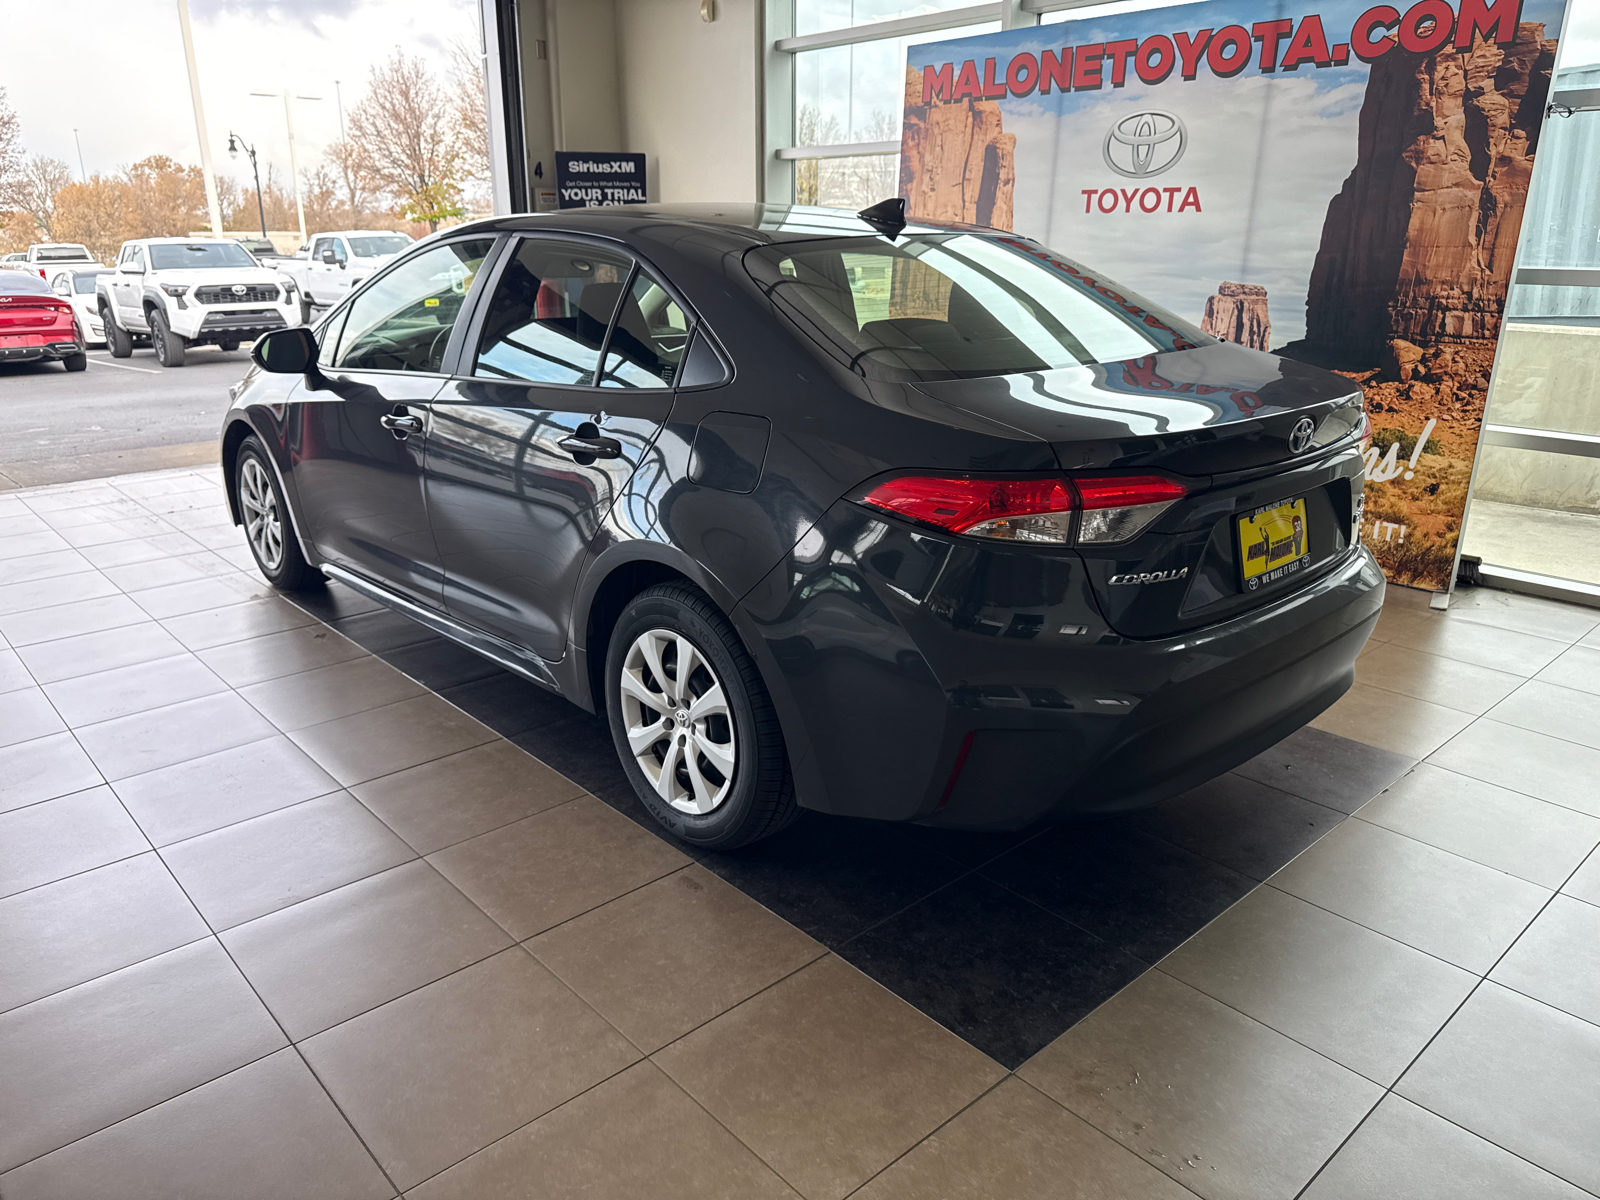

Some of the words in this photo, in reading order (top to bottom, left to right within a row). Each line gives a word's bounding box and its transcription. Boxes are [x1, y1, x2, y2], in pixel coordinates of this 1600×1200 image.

[922, 0, 1522, 105] MALONETOYOTA.COM
[534, 161, 543, 179] 4
[568, 160, 635, 173] SiriusXM
[561, 188, 602, 201] YOUR
[604, 188, 647, 201] TRIAL
[1081, 186, 1202, 214] TOYOTA
[1372, 521, 1406, 544] IT!
[1108, 566, 1189, 585] COROLLA
[1262, 574, 1270, 584] WE
[1270, 568, 1283, 579] MAKE
[1283, 564, 1289, 574] IT
[1289, 561, 1300, 573] EASY
[649, 803, 678, 829] AVID
